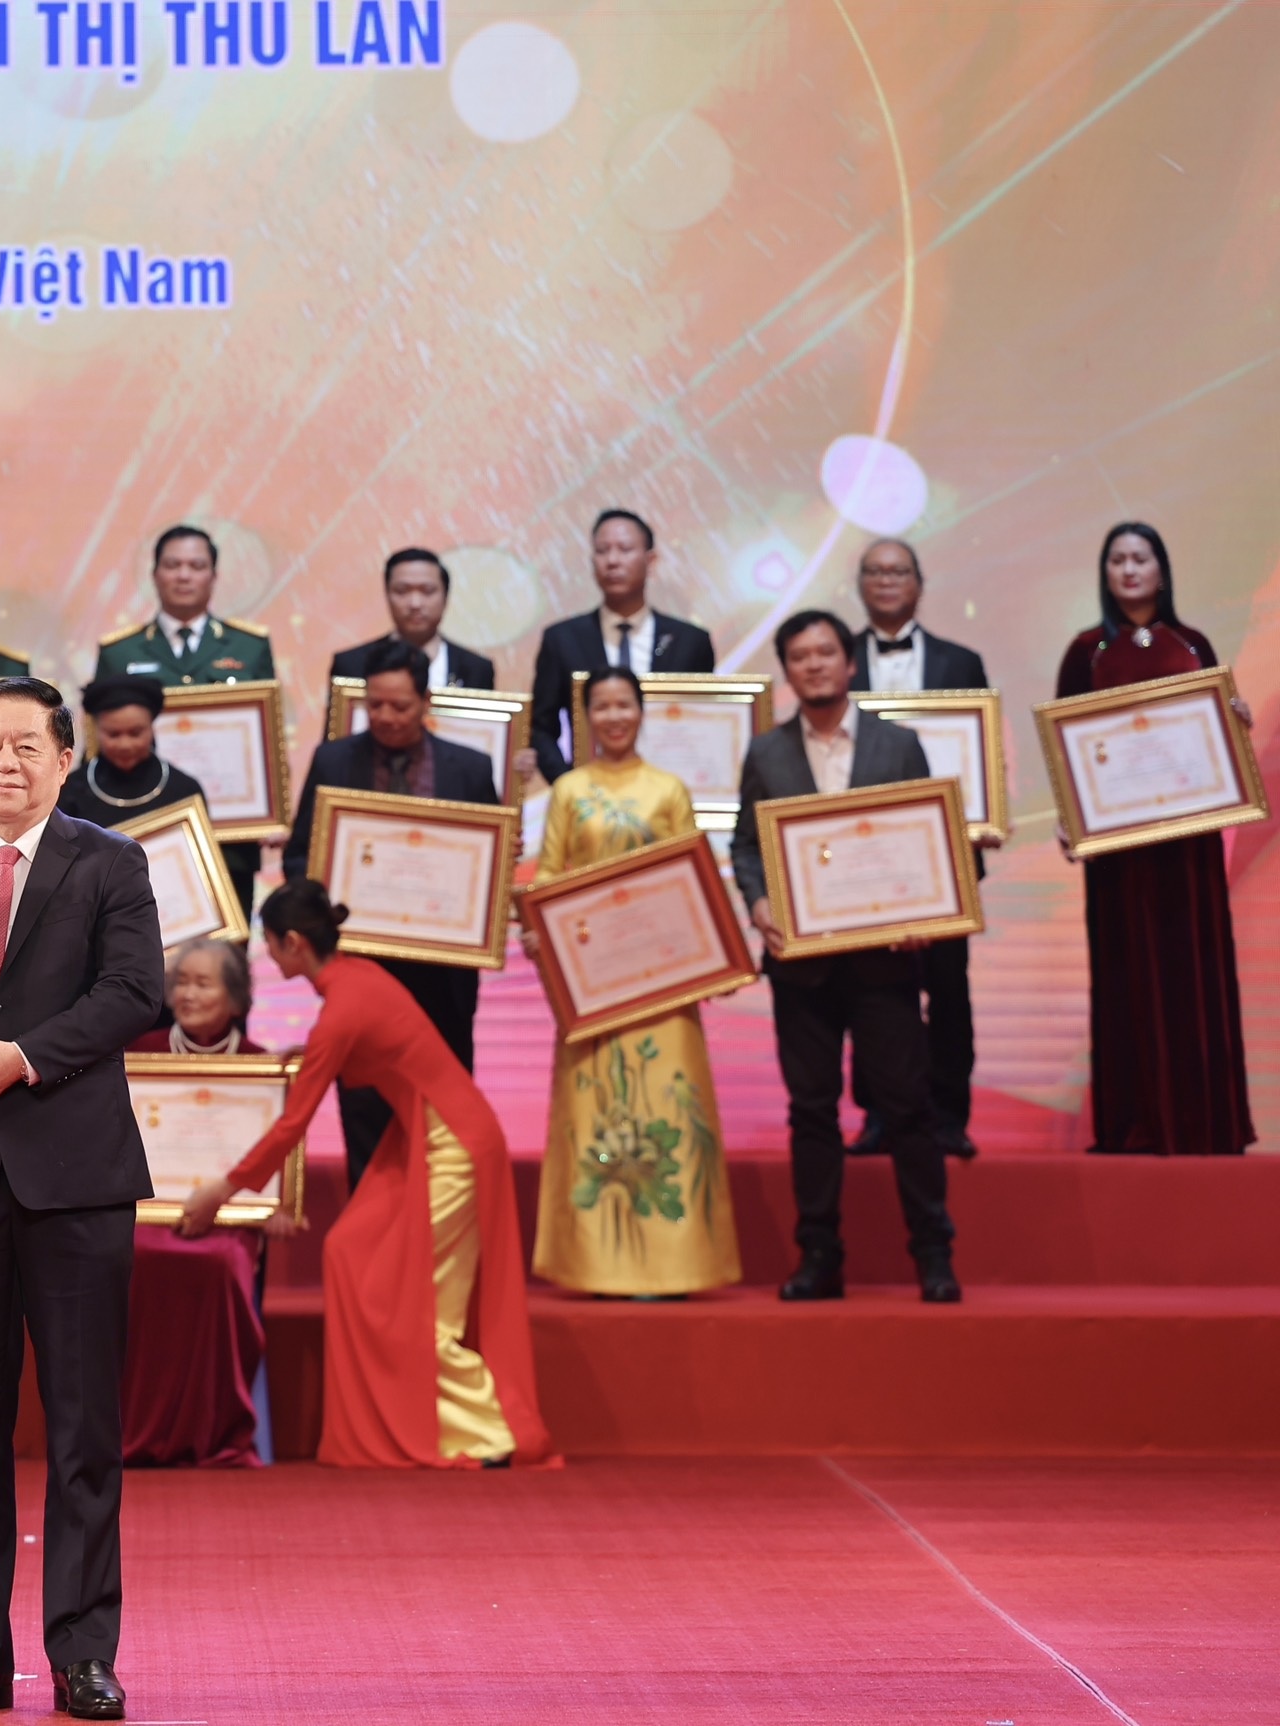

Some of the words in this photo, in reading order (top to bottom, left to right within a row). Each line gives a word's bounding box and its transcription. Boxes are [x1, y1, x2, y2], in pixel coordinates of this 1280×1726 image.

[35, 1, 137, 83] THỊ
[163, 0, 288, 67] THU
[315, 0, 442, 65] LAN
[105, 249, 228, 305] Nam
